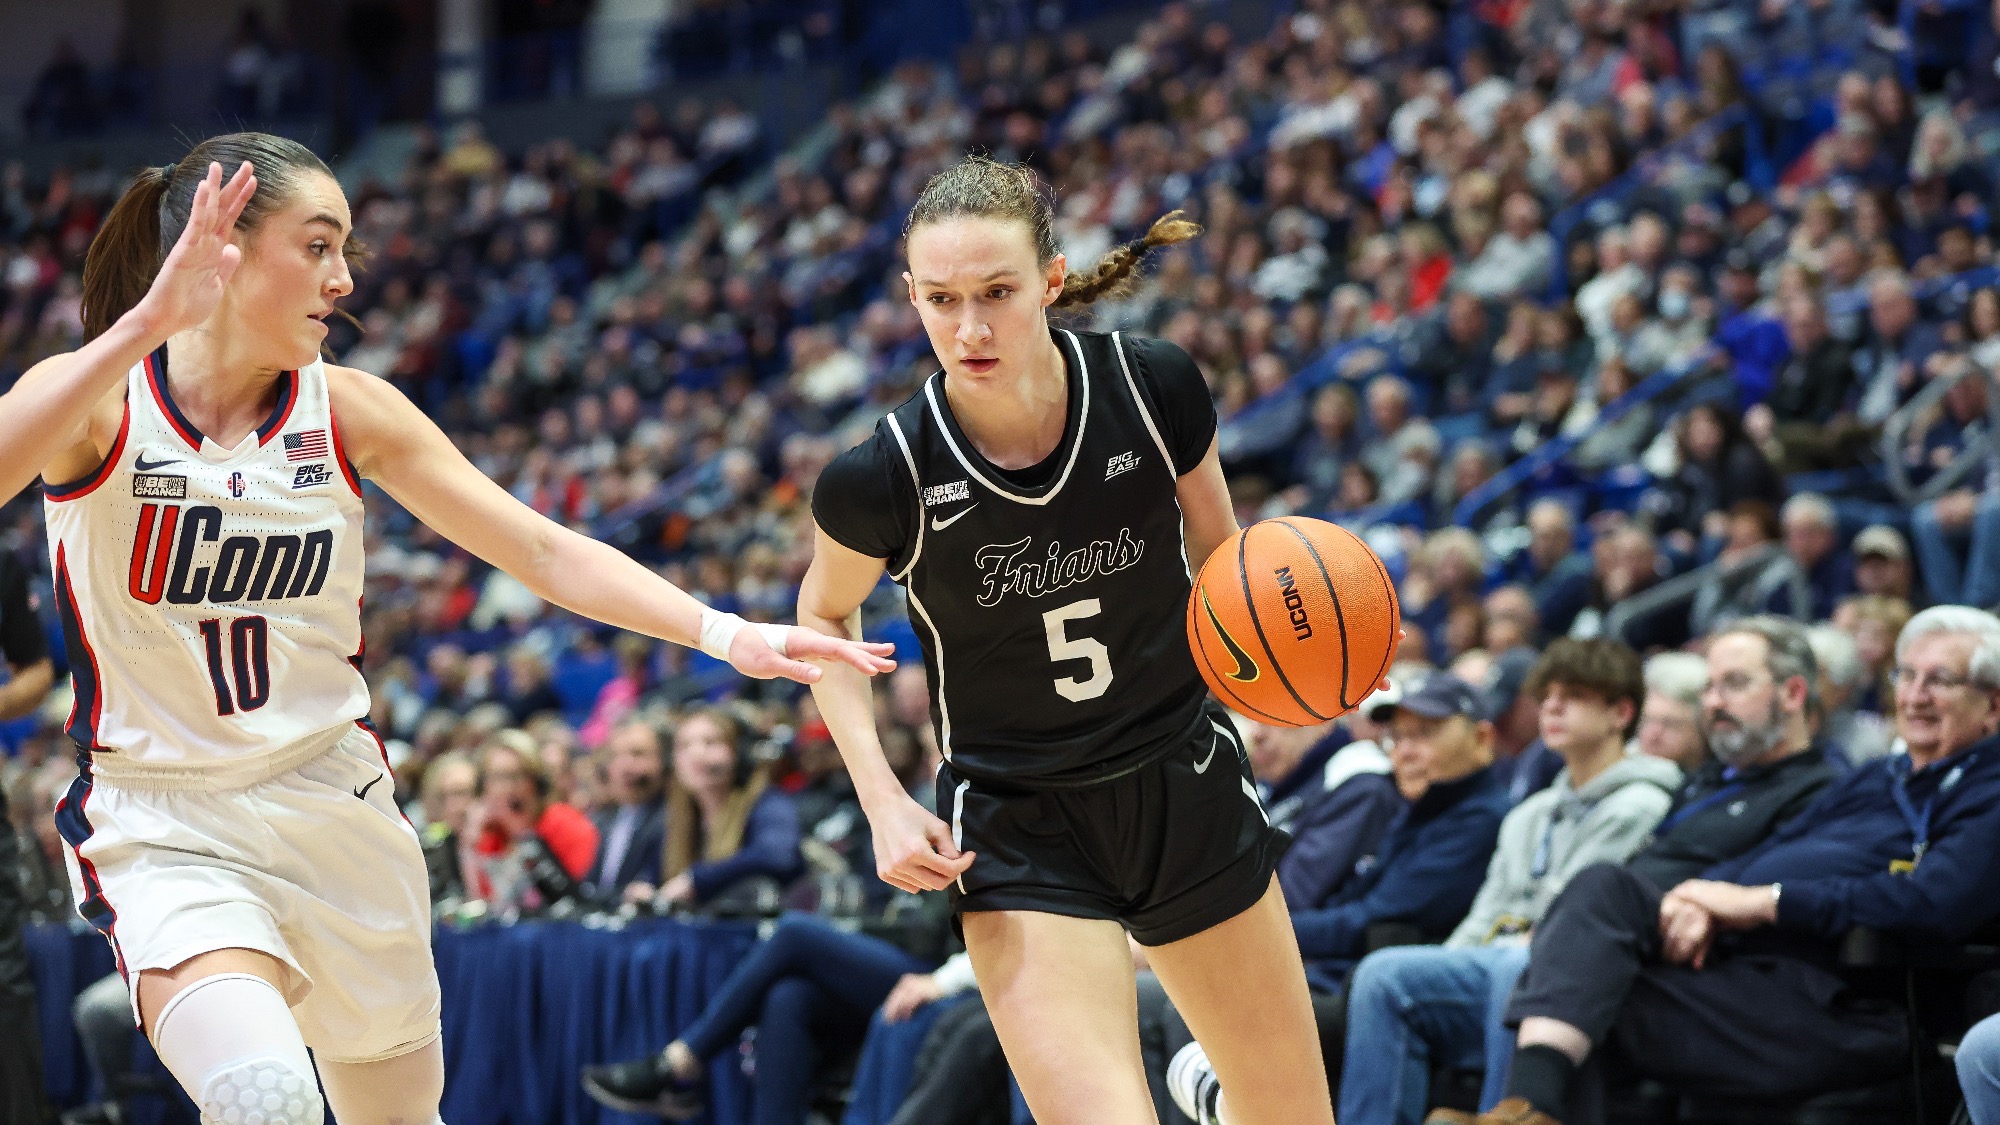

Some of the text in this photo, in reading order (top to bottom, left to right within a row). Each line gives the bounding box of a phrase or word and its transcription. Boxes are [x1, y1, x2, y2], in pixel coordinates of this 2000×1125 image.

[294, 471, 333, 485] EAST
[296, 463, 326, 476] BIG
[1105, 456, 1142, 477] EAST
[1107, 450, 1133, 467] BIG
[134, 487, 185, 497] CHANGE
[128, 503, 333, 605] UConn
[975, 527, 1145, 607] Friars
[1274, 565, 1313, 642] UCONN
[199, 615, 271, 716] 10
[1042, 597, 1114, 703] 5
